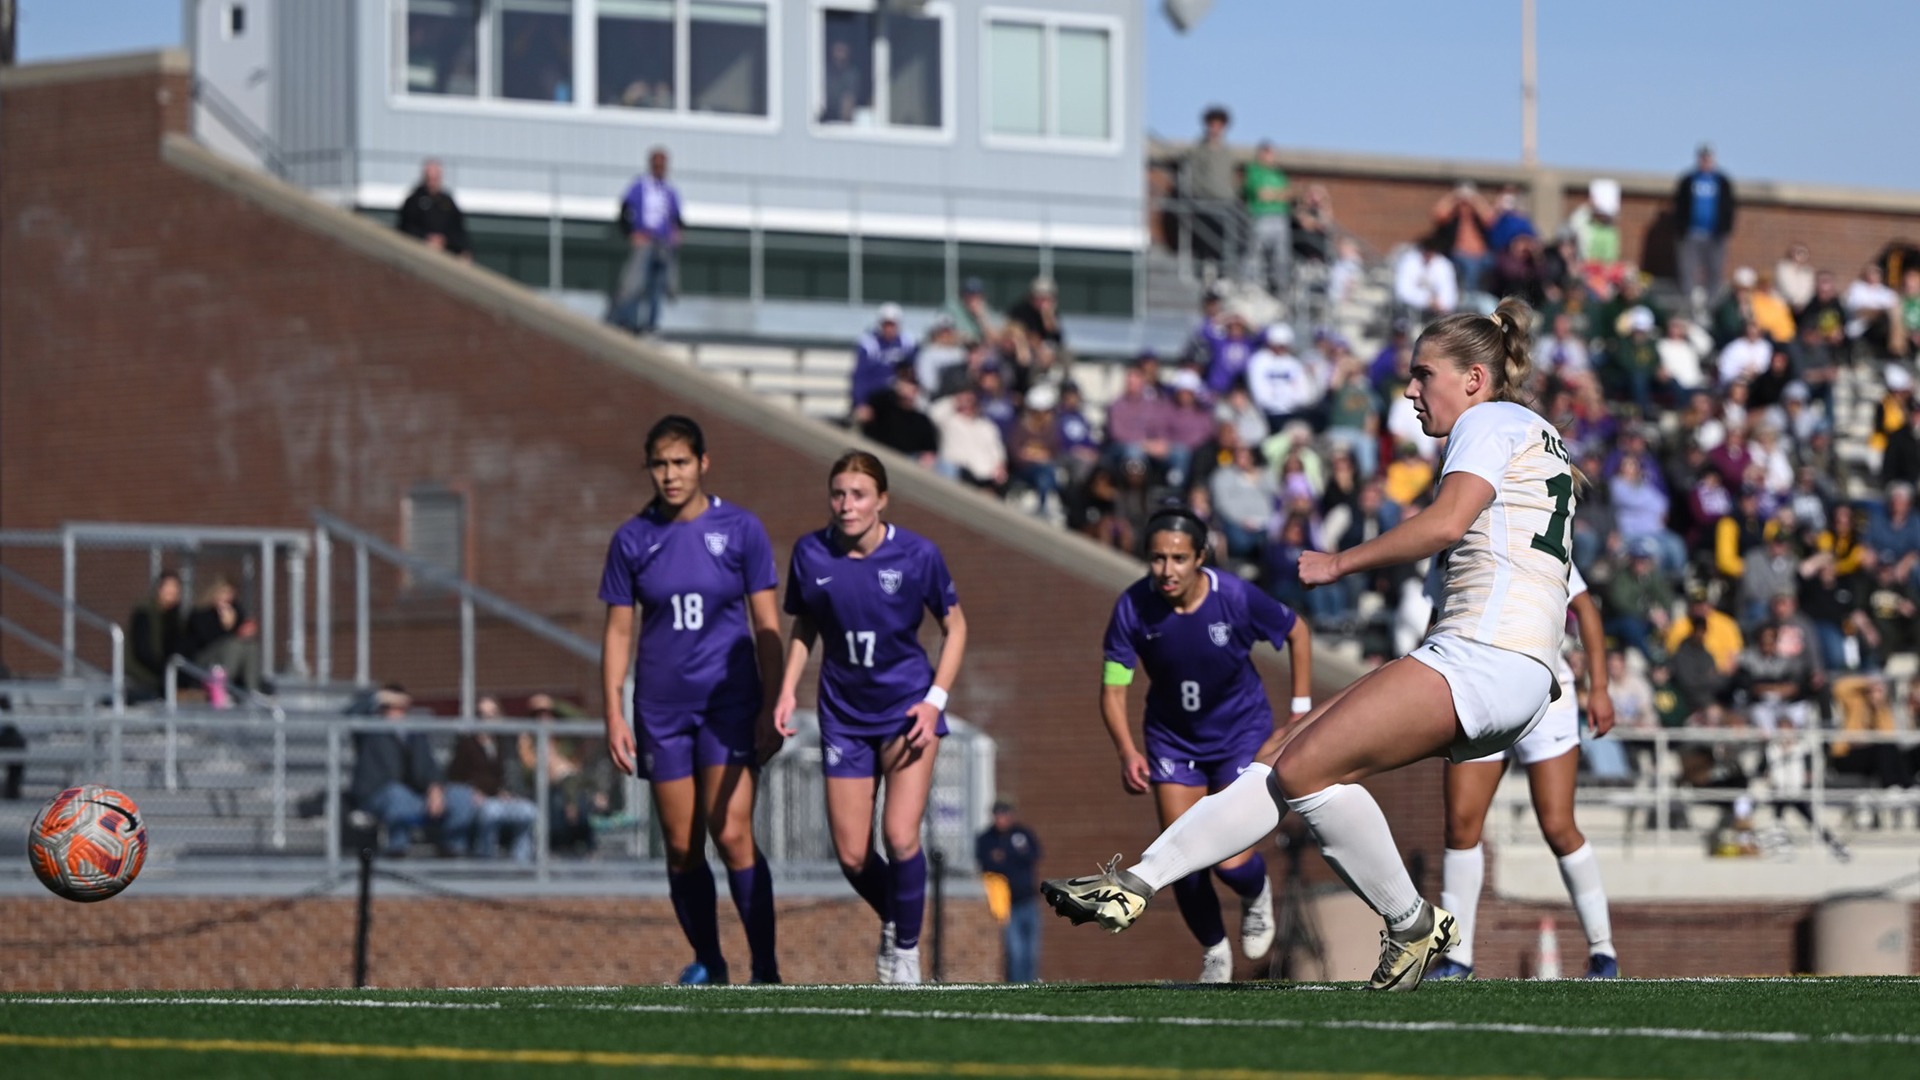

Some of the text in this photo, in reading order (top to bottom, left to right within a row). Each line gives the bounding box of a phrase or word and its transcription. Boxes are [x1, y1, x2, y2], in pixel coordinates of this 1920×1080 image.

[671, 593, 704, 631] 18
[845, 630, 876, 668] 17
[1180, 680, 1201, 712] 8
